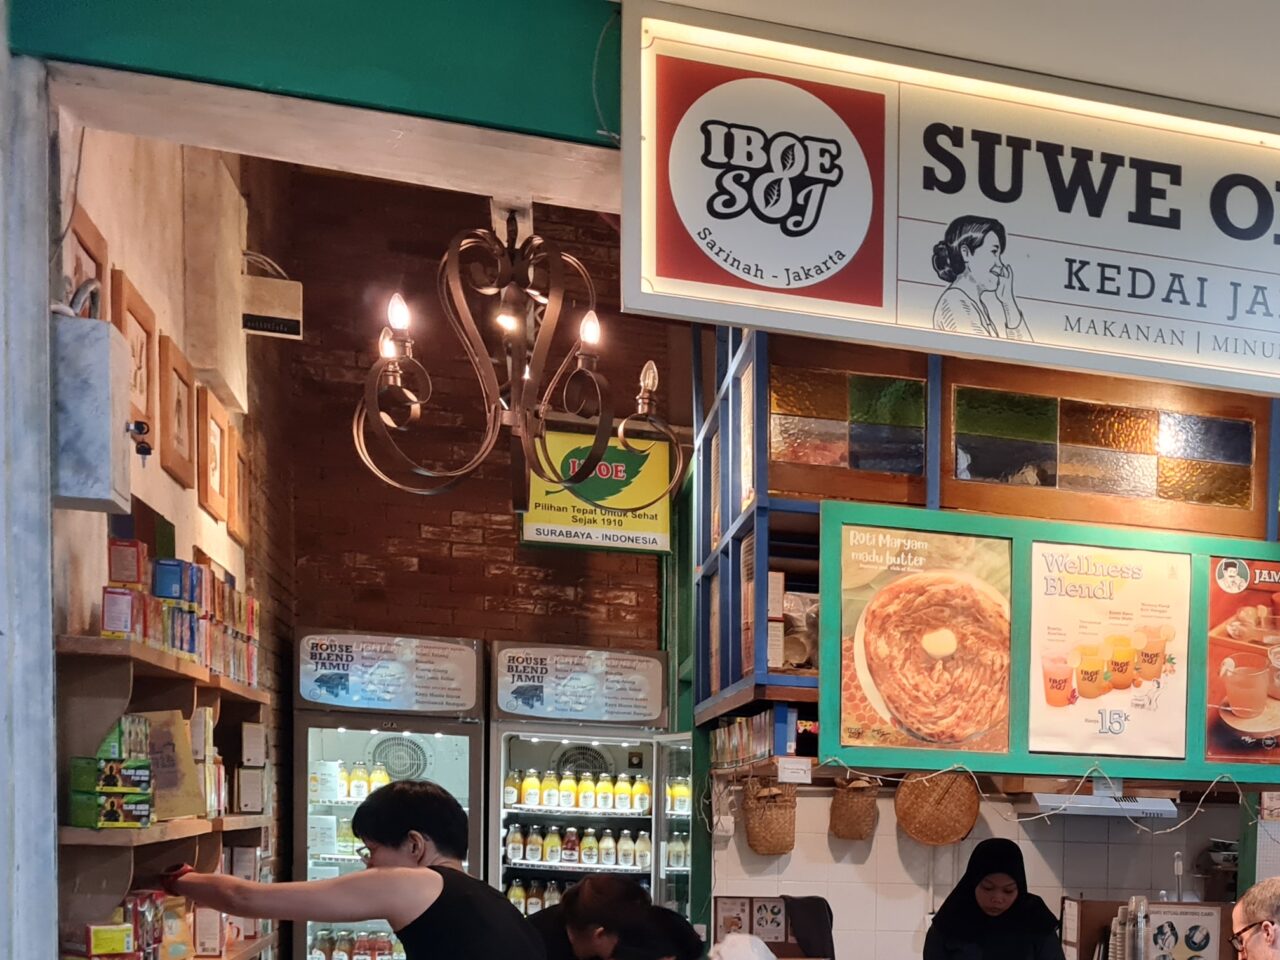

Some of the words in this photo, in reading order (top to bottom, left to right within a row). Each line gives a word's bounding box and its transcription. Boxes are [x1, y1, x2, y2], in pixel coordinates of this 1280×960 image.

[701, 119, 843, 187] IBOE
[922, 121, 1183, 230] SUWE
[697, 226, 766, 281] Sarinah
[783, 248, 848, 286] Jakarta
[1063, 257, 1209, 309] KEDAI
[1063, 314, 1186, 348] MAKANAN
[569, 458, 627, 480] IOE
[534, 502, 568, 513] Pilihan
[571, 505, 597, 516] Tepat
[631, 511, 658, 521] Sehat
[571, 515, 598, 526] Sejak
[601, 518, 624, 528] 1910
[535, 527, 593, 541] SURABAYA
[601, 532, 659, 546] INDONESIA
[849, 529, 876, 546] Roti
[878, 533, 929, 550] Maryam
[851, 549, 882, 563] madu
[886, 550, 926, 566] butter
[1042, 552, 1144, 580] Wellness
[1043, 576, 1115, 601] Blend!
[310, 641, 353, 654] HOUSE
[310, 651, 354, 663] BLEND
[314, 661, 350, 672] JAMU
[507, 655, 548, 666] HOUSE
[507, 664, 548, 675] BLEND
[511, 673, 545, 684] JAMU
